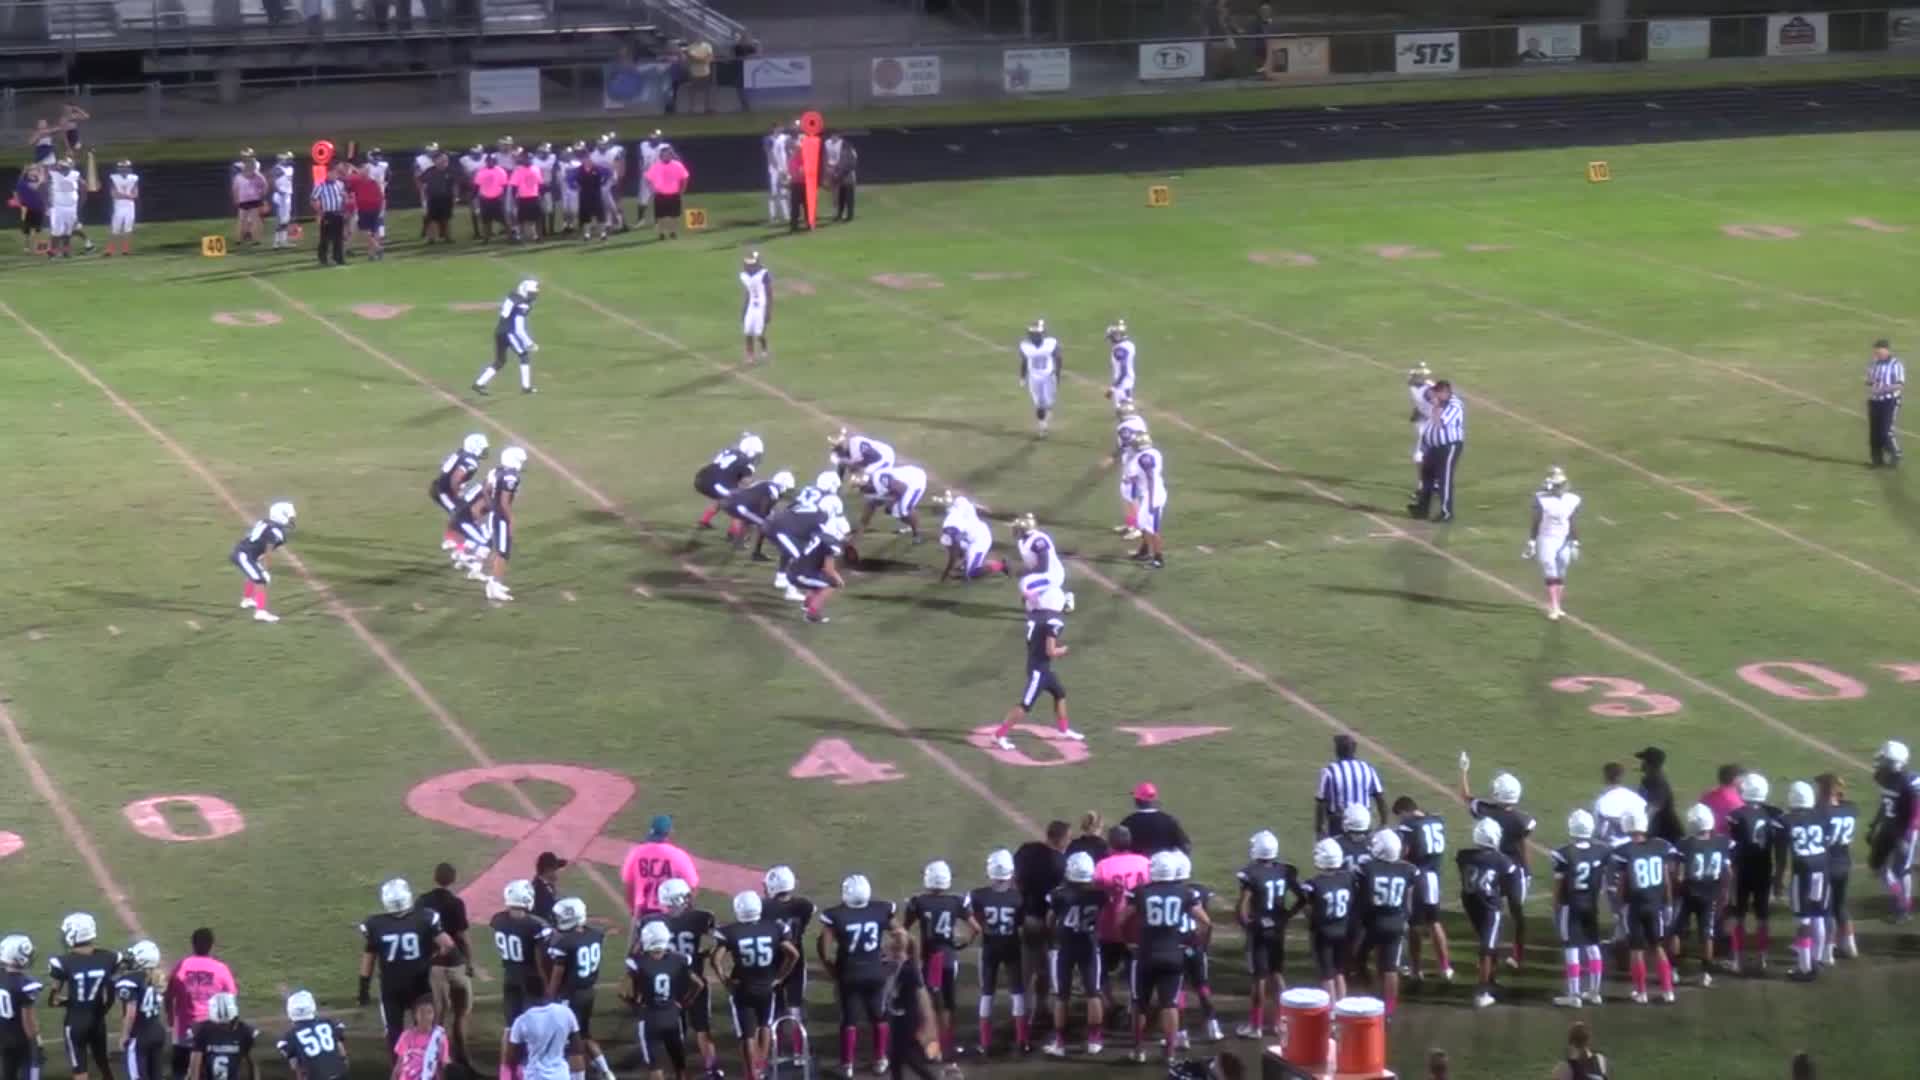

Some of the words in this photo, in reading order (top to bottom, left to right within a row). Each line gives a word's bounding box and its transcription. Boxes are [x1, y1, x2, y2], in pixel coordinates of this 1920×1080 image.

[1413, 43, 1455, 65] STS
[207, 238, 224, 253] 40
[1421, 822, 1446, 855] 15
[1791, 824, 1825, 857] 22
[1829, 816, 1856, 846] 72
[1633, 855, 1664, 889] 80
[1372, 876, 1408, 908] 50
[1146, 895, 1182, 927] 60
[381, 932, 421, 962] 79
[495, 930, 523, 963] 90
[738, 935, 774, 967] 55
[845, 921, 879, 952] 73
[577, 942, 601, 978] 99
[73, 969, 106, 1002] 17
[654, 972, 671, 1001] 9
[299, 1023, 336, 1057] 58
